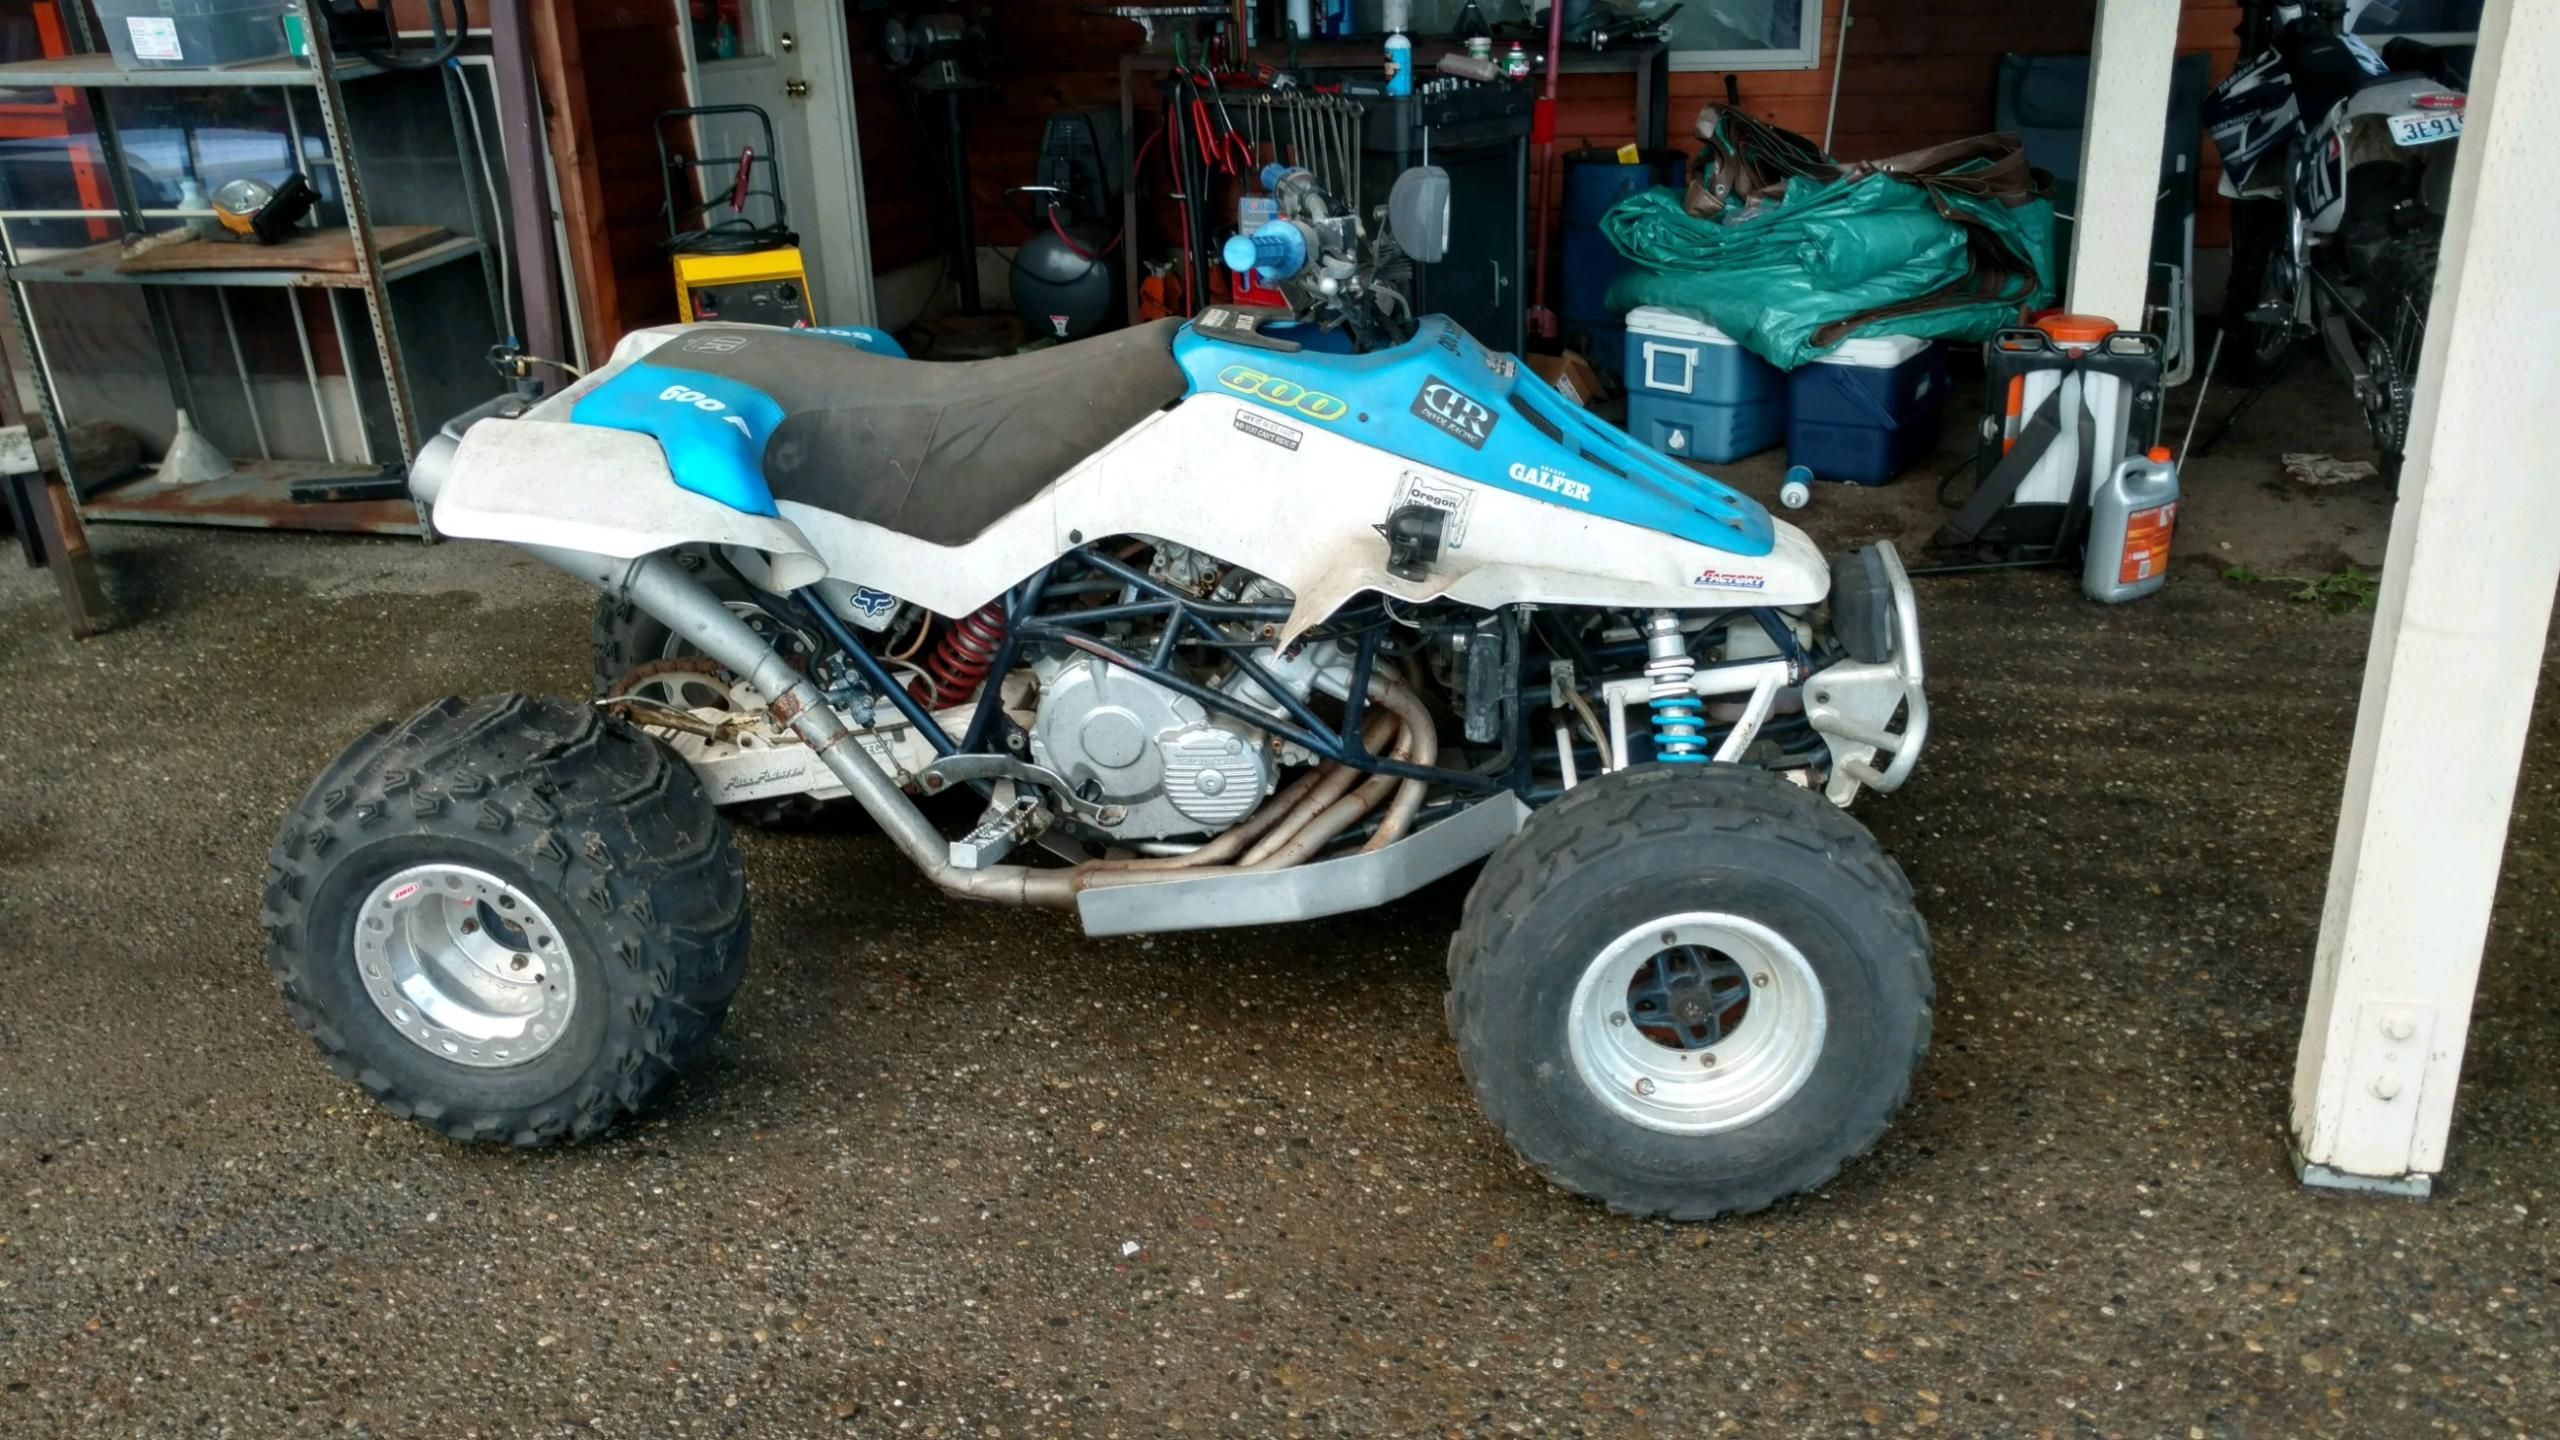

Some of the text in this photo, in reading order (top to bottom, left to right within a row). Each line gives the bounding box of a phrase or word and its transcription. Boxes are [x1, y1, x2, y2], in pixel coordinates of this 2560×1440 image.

[659, 384, 726, 411] 600
[1217, 364, 1348, 421] 600
[1411, 488, 1457, 509] Oregon
[1509, 462, 1591, 502] GALFER
